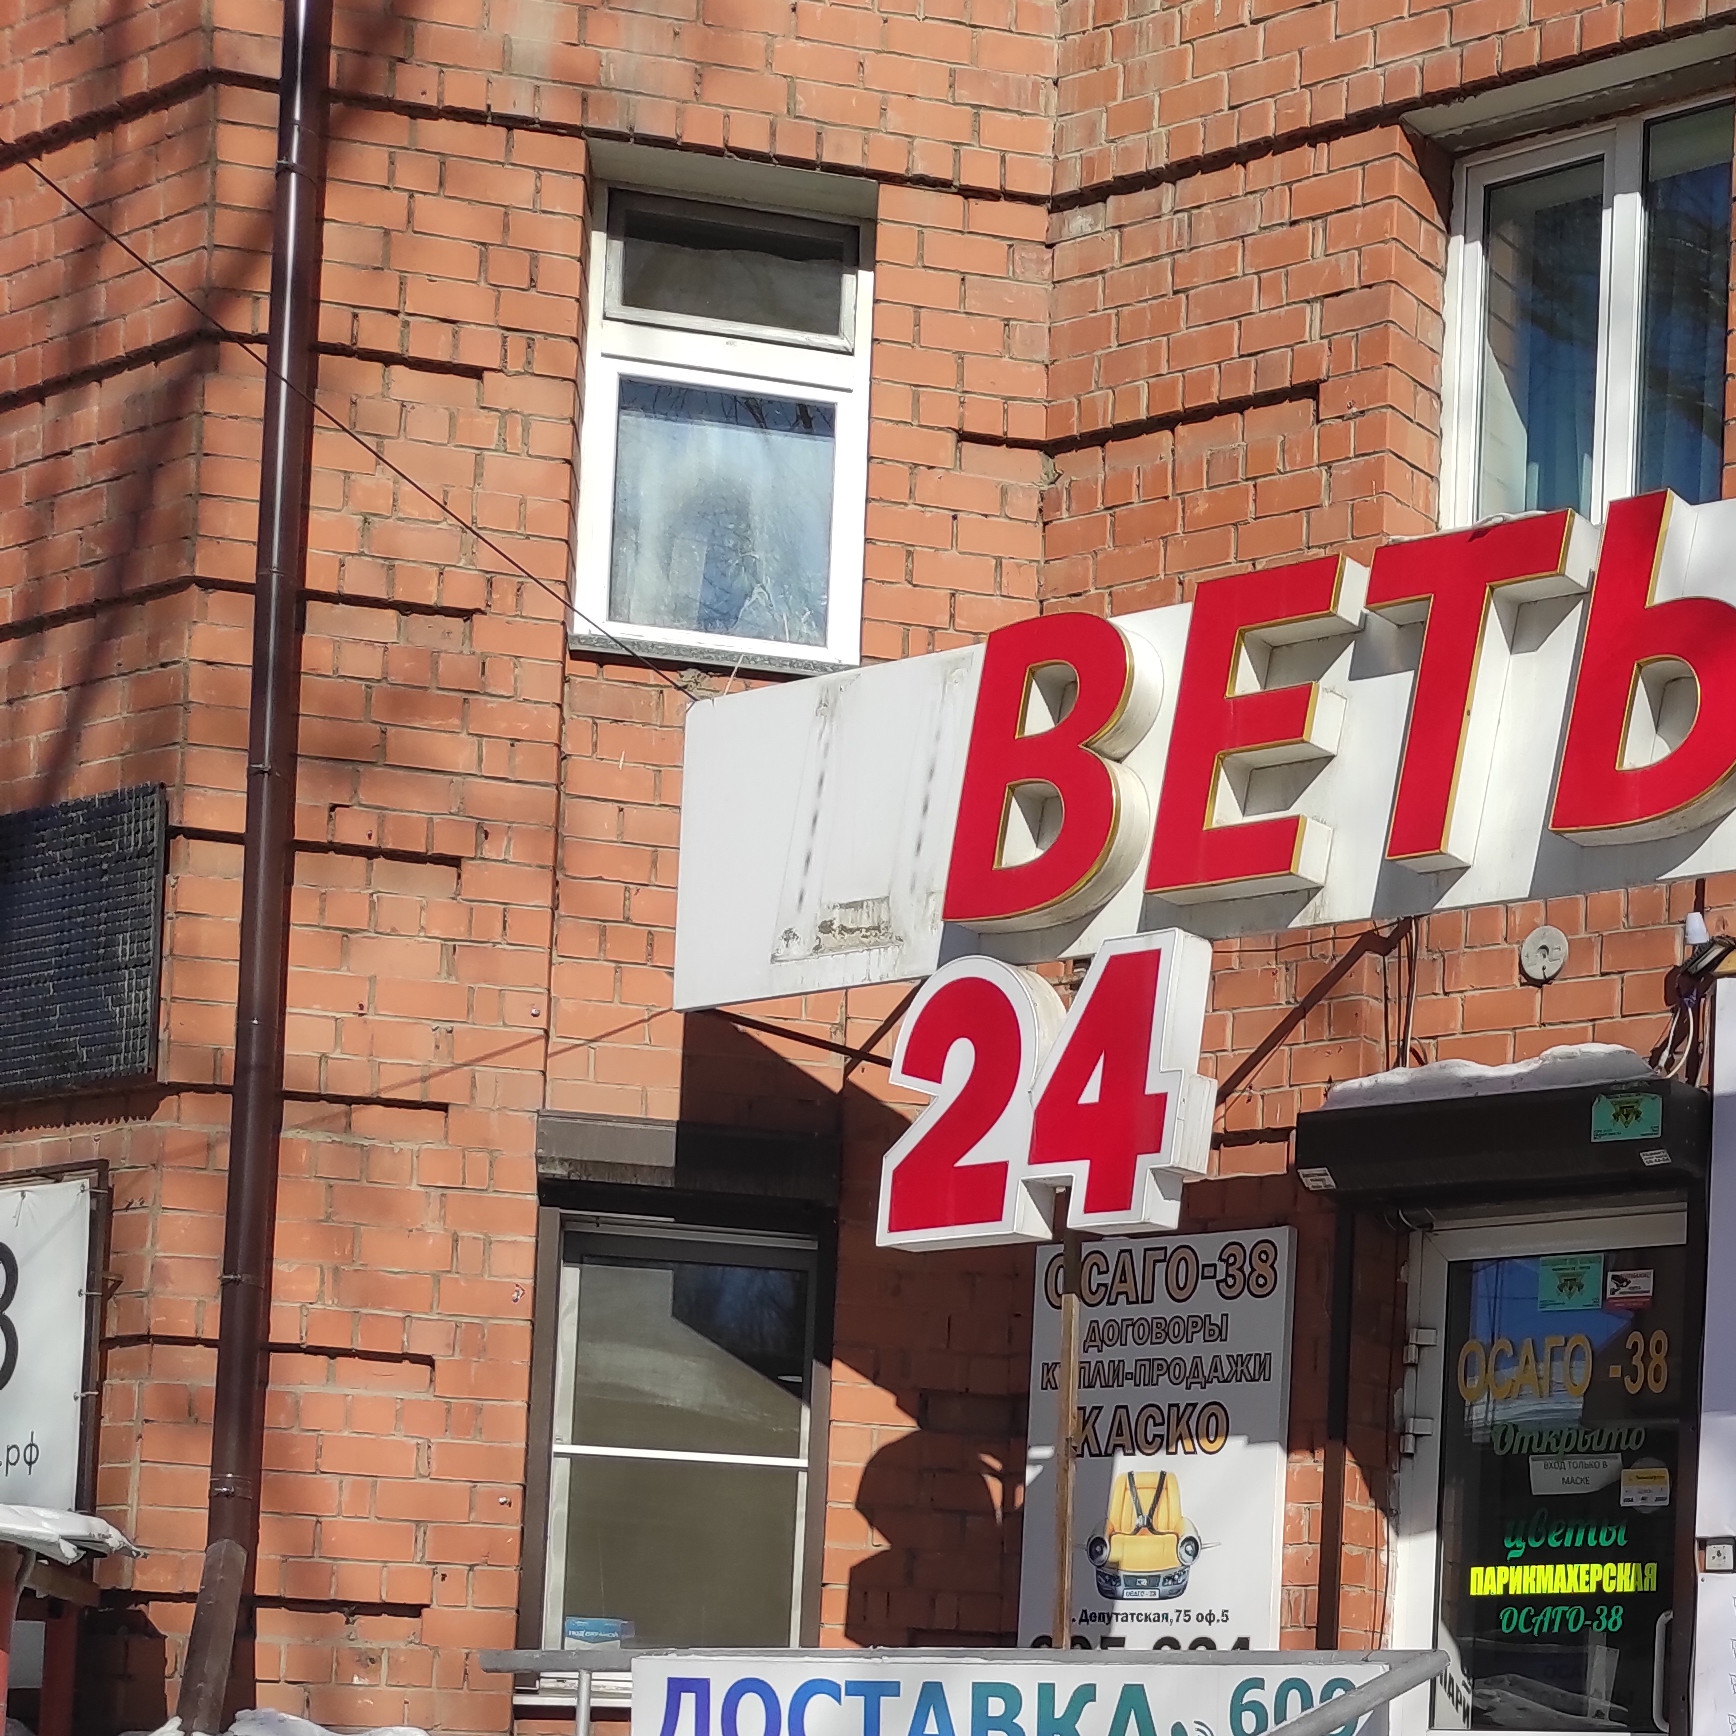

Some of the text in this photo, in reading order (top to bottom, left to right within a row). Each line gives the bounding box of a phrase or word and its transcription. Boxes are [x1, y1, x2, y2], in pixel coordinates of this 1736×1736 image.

[887, 948, 1170, 1234] 24
[1083, 1313, 1229, 1353] ДОГОВОРЫ
[1041, 1352, 1272, 1391] КПЛИ-ПРОДАЖИ
[1457, 1333, 1594, 1402] ОСАГО
[1075, 1401, 1230, 1459] КАСКО
[1493, 1421, 1647, 1456] Открыто
[1543, 1460, 1608, 1471] ВХОД ТОЛЬКО В
[1561, 1476, 1590, 1485] МАСКЕ
[1503, 1508, 1629, 1561] цветы
[1470, 1562, 1658, 1596] ПАРИКМАХЕРСКАЯ
[1499, 1605, 1625, 1636] ОСАГО-38
